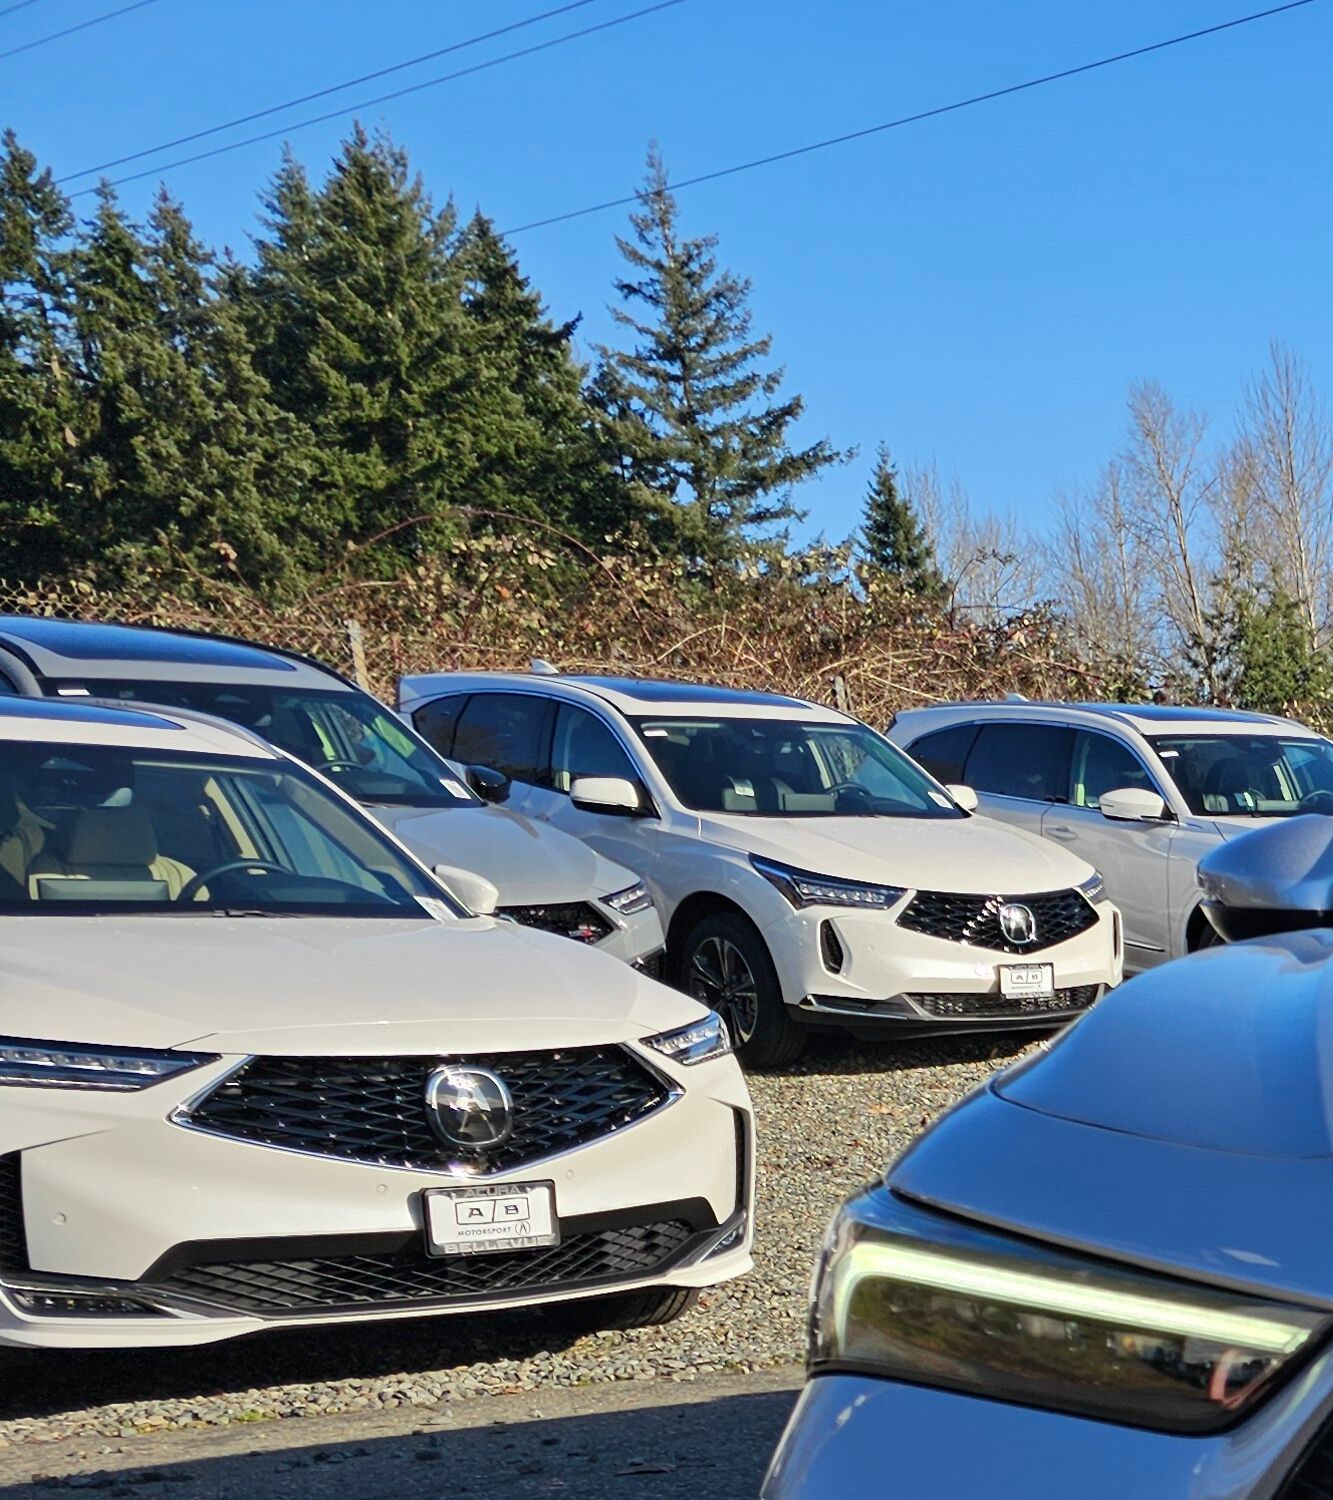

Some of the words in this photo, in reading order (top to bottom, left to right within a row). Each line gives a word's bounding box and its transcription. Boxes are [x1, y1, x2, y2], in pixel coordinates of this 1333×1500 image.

[464, 1186, 522, 1198] ACURA
[457, 1226, 512, 1237] MOTORSPORT
[444, 1234, 552, 1254] BELLEVUE
